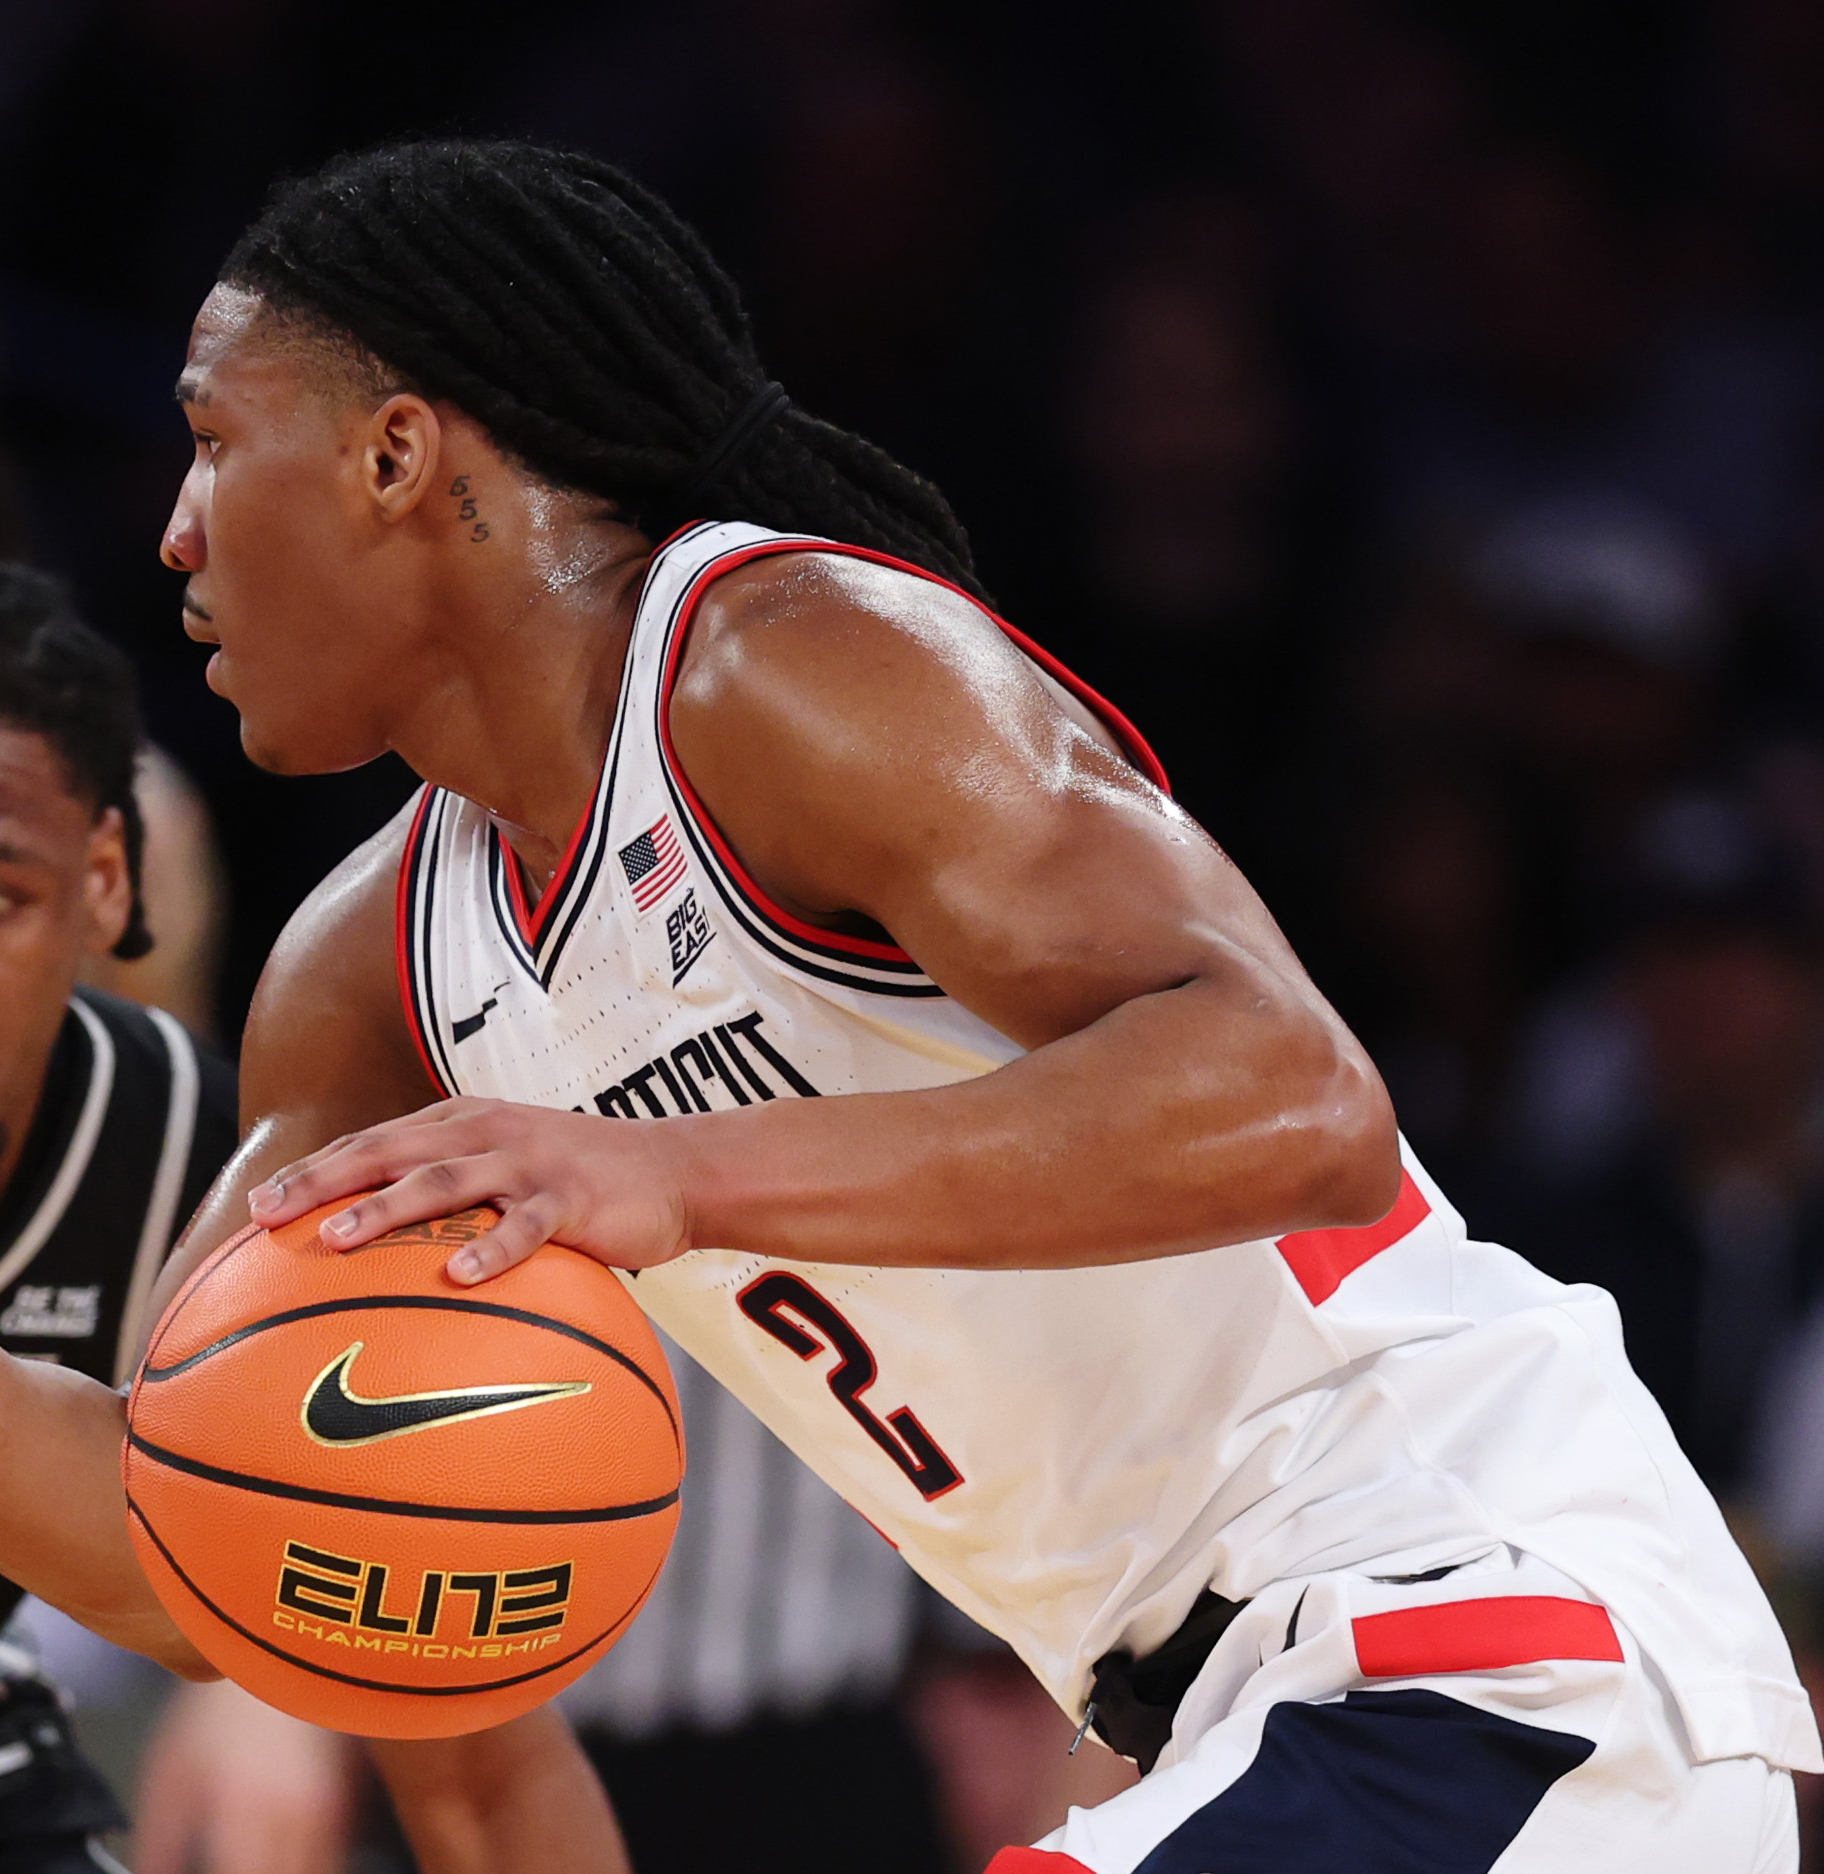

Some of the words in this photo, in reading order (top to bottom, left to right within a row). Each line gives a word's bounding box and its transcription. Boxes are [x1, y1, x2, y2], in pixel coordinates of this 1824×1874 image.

[666, 887, 697, 945] BIG
[735, 1270, 965, 1502] 2
[275, 1538, 575, 1640] ELITE
[273, 1611, 562, 1660] CHAMPIONSHIP
